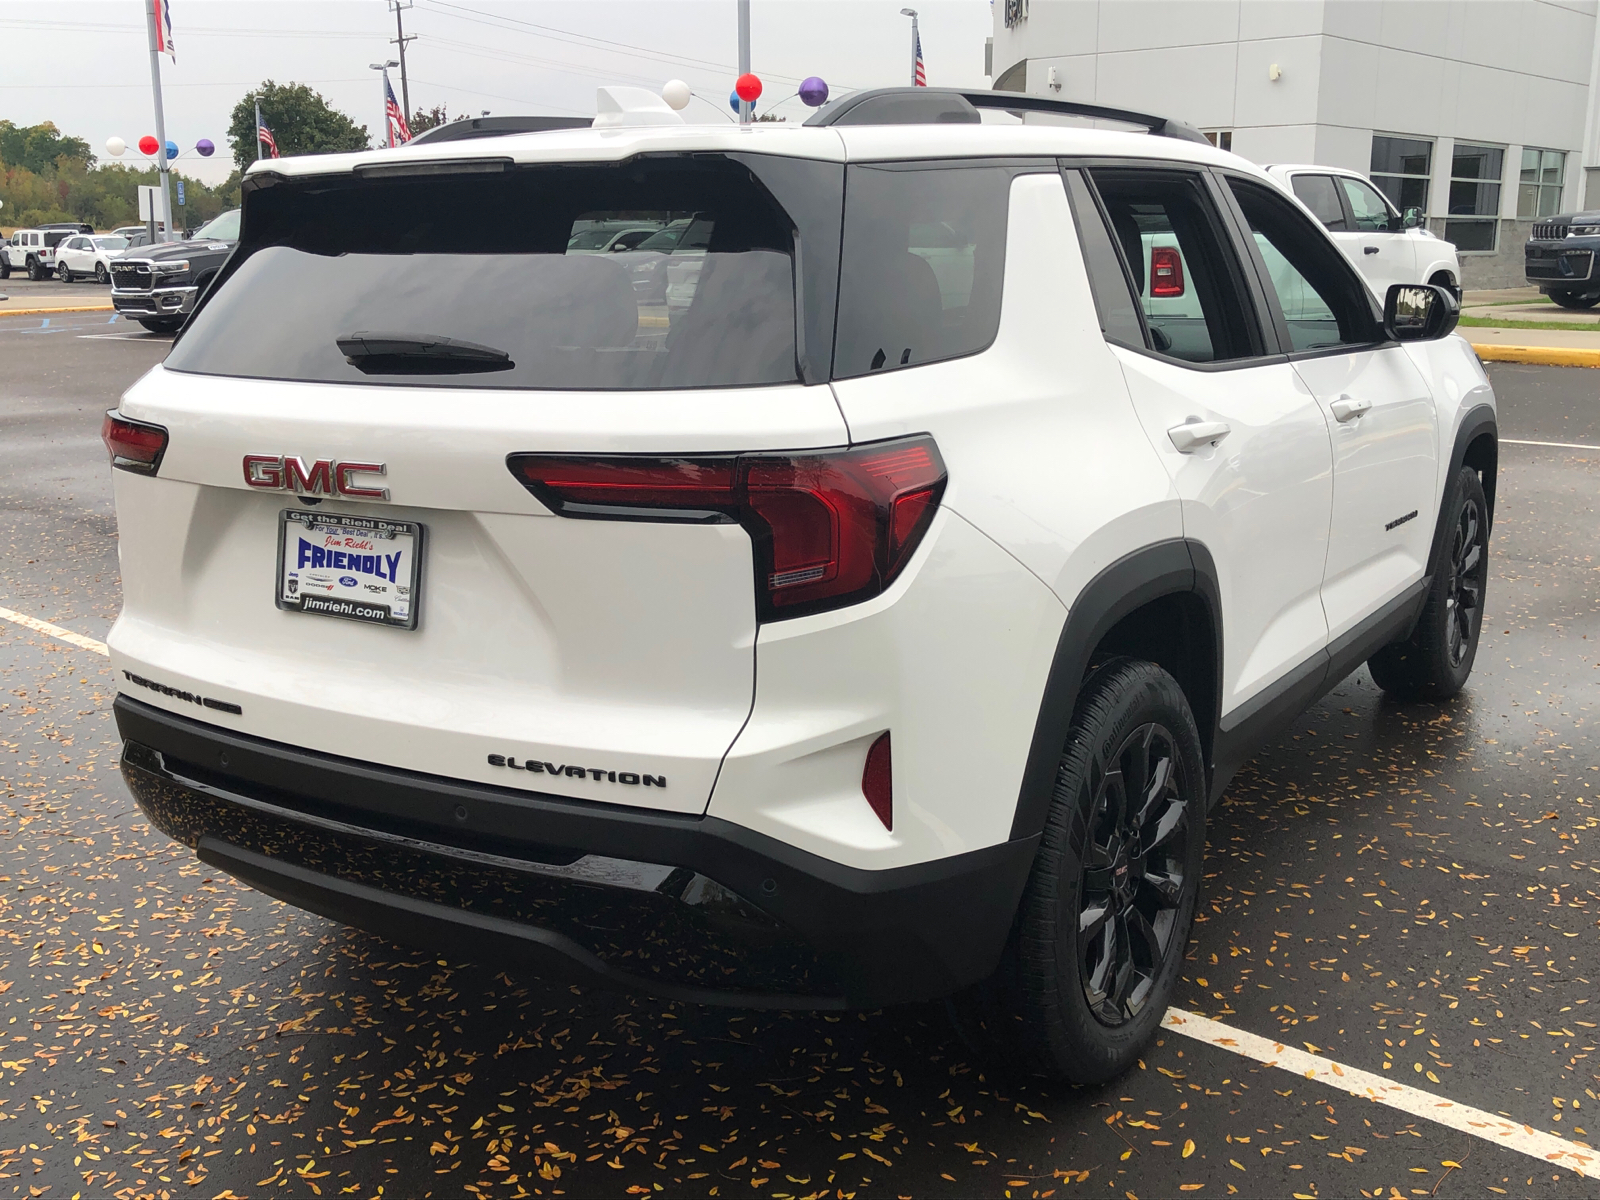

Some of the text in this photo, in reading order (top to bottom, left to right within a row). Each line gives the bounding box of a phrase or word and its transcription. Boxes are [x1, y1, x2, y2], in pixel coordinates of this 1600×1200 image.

[243, 454, 391, 501] GMC
[291, 513, 407, 532] Get the Riehl Deal
[325, 526, 339, 534] Your
[324, 535, 374, 550] Jim Riehl's
[297, 536, 402, 584] FRIENDLY
[363, 584, 387, 592] MOKE
[303, 598, 385, 619] jimriehl.com
[121, 669, 203, 706] TERRAIN
[487, 753, 667, 788] ELEVATION
